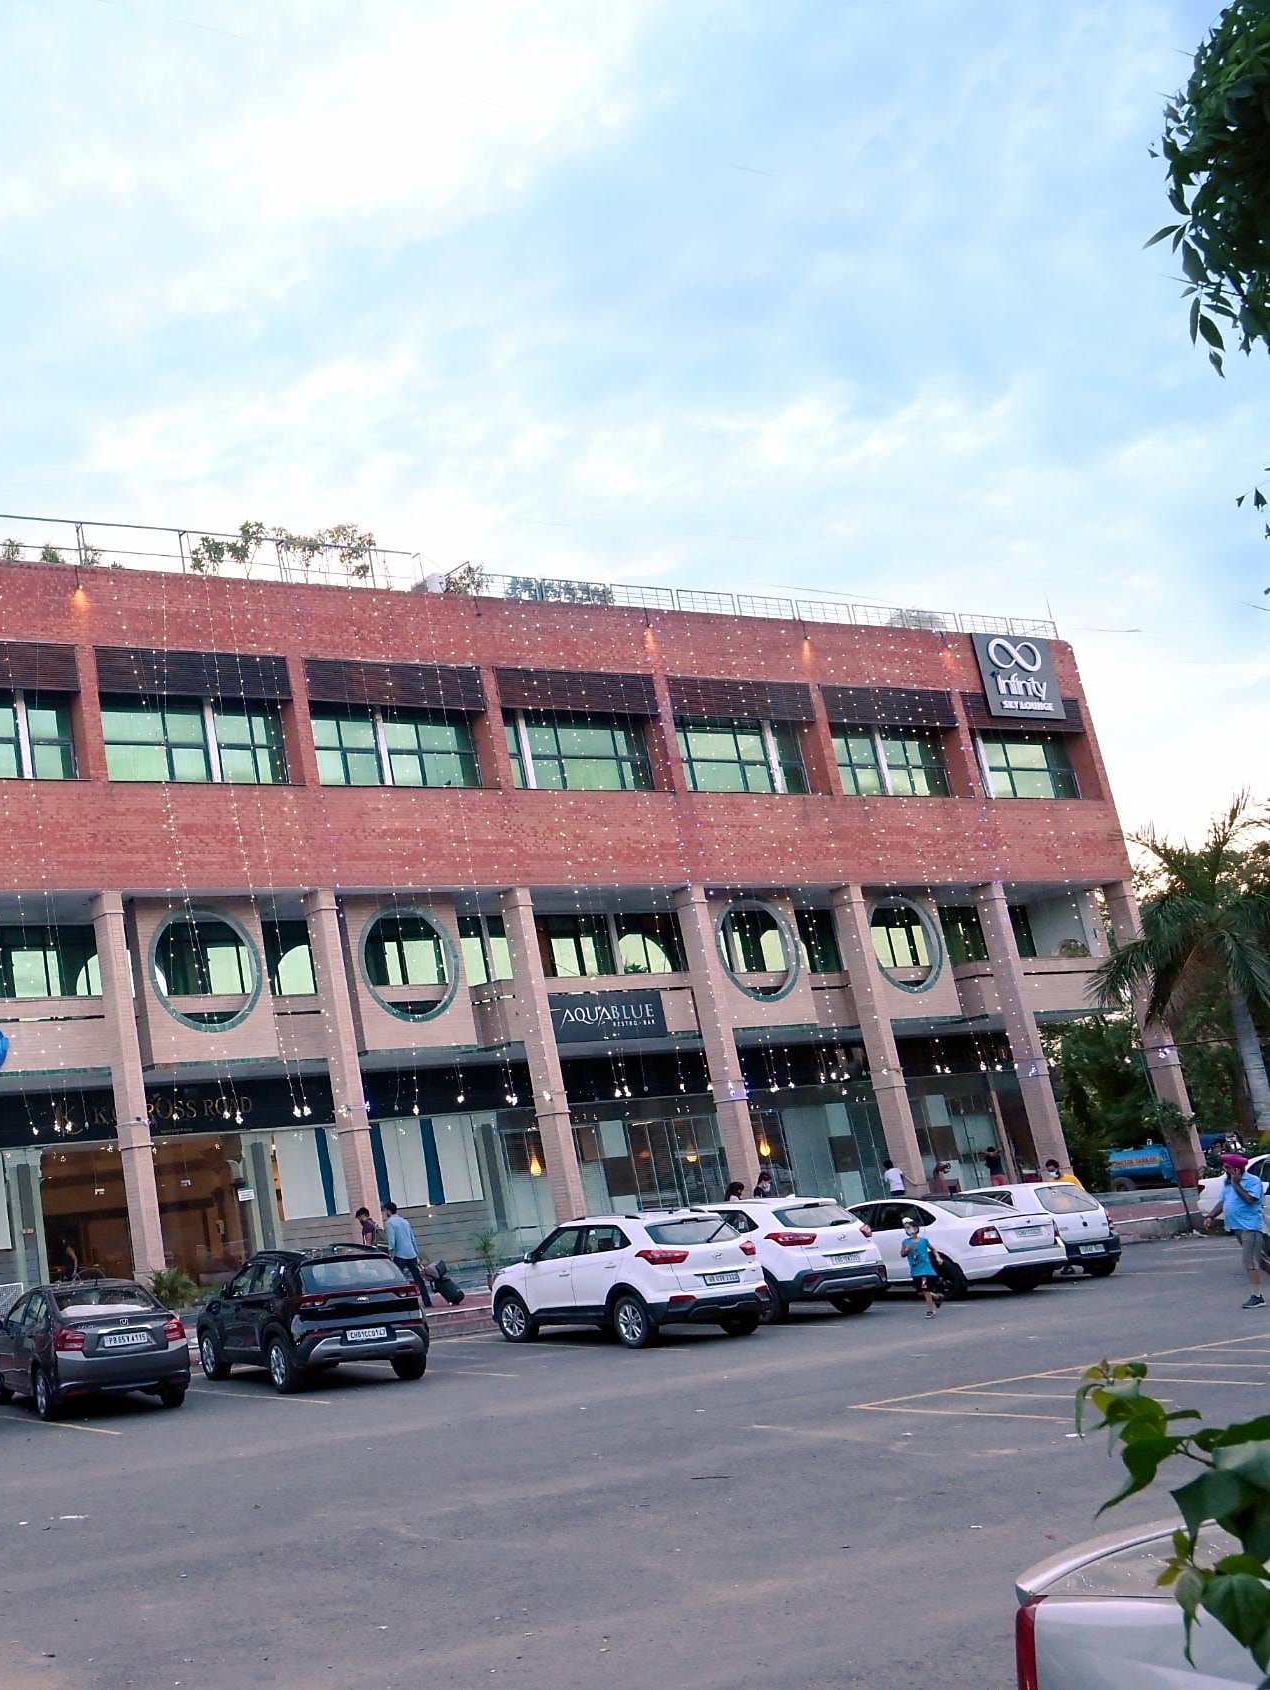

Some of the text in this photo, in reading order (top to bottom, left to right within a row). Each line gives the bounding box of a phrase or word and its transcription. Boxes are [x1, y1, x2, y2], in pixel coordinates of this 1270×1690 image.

[1001, 700, 1055, 711] SKY LOUNGE
[201, 1096, 253, 1117] ROAD
